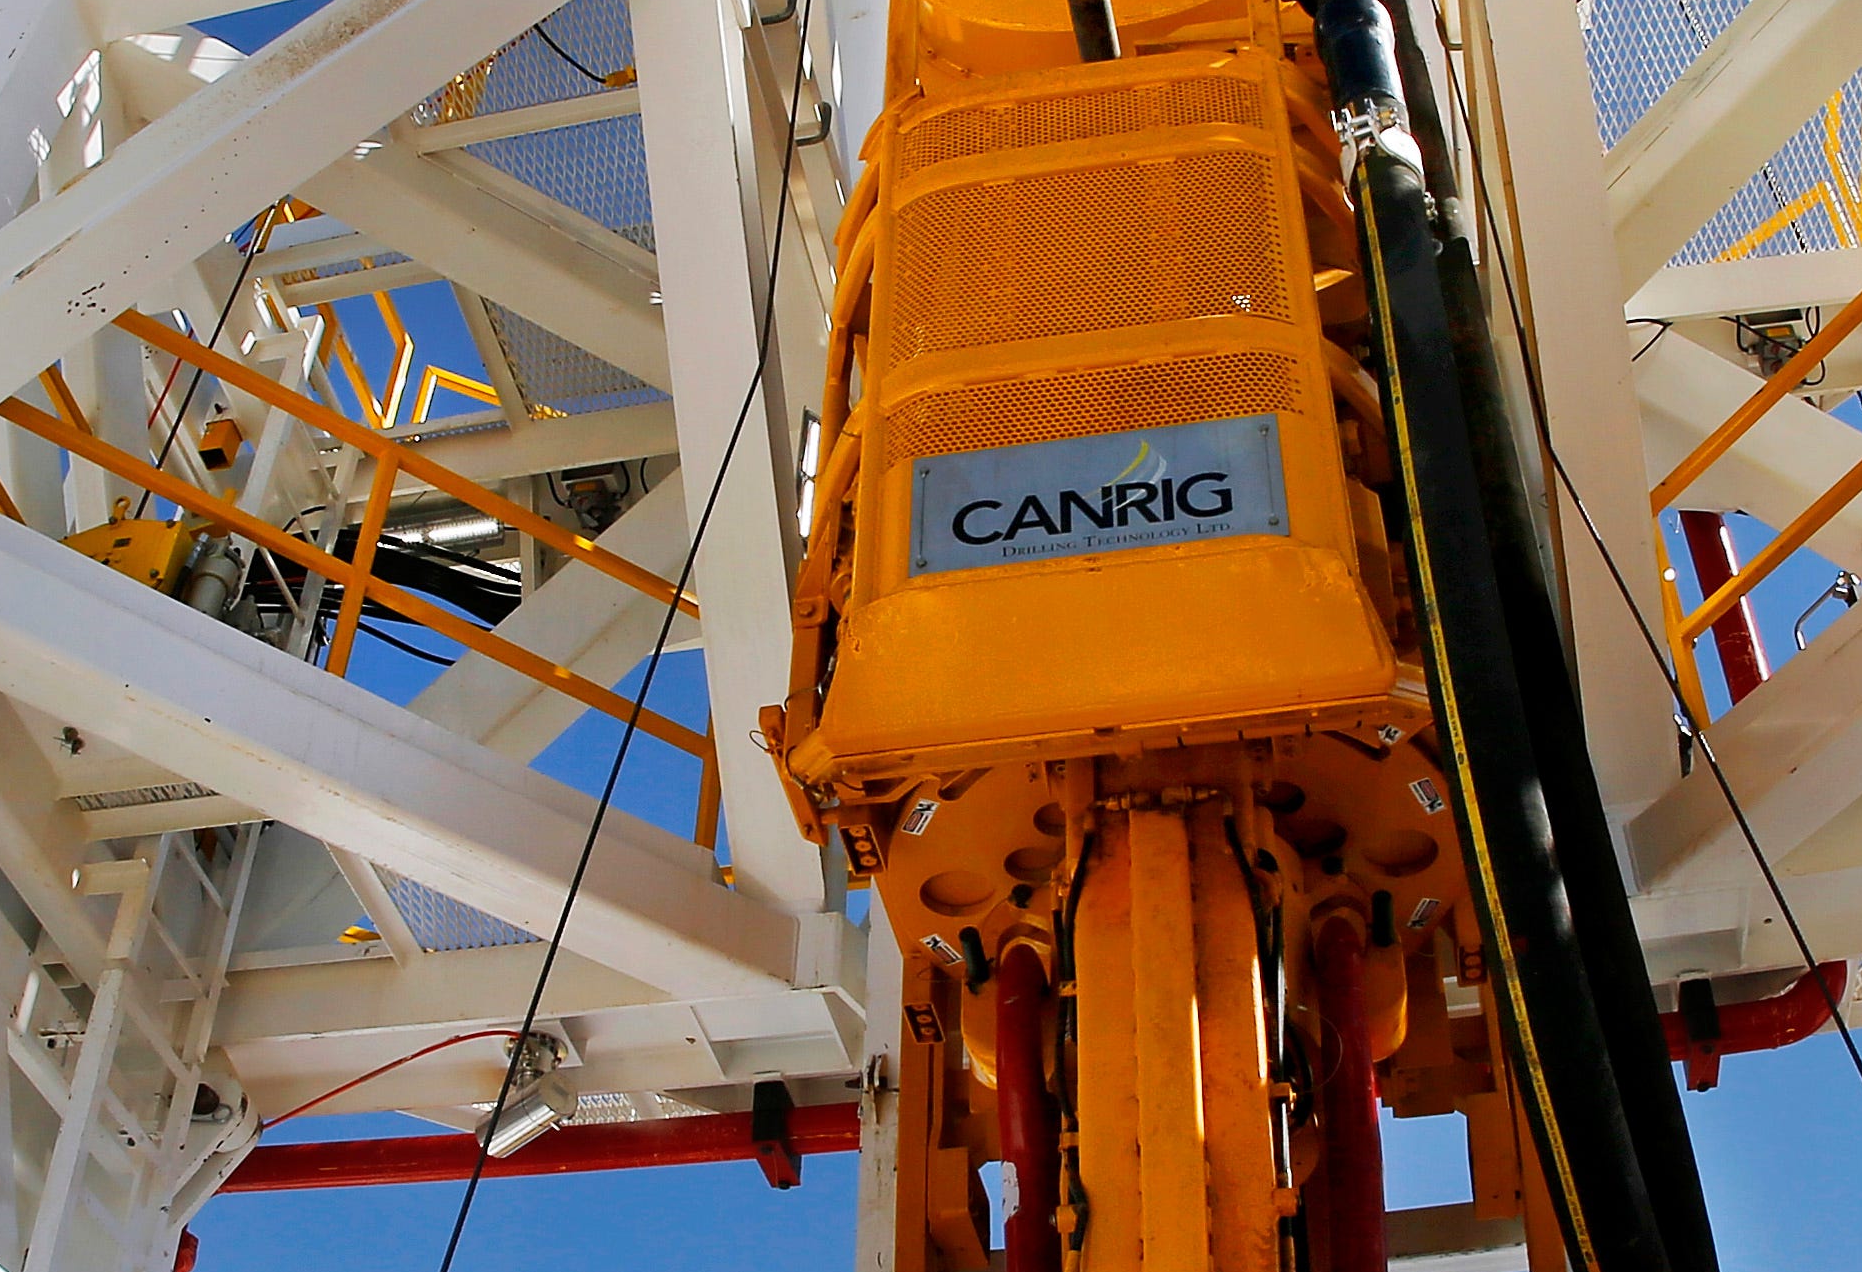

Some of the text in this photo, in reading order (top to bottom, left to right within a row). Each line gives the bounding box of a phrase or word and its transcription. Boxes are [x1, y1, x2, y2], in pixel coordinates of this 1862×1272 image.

[951, 472, 1233, 546] CANRIG
[1001, 540, 1078, 558] DRILLING
[1082, 528, 1189, 549] TECHNOLOGY
